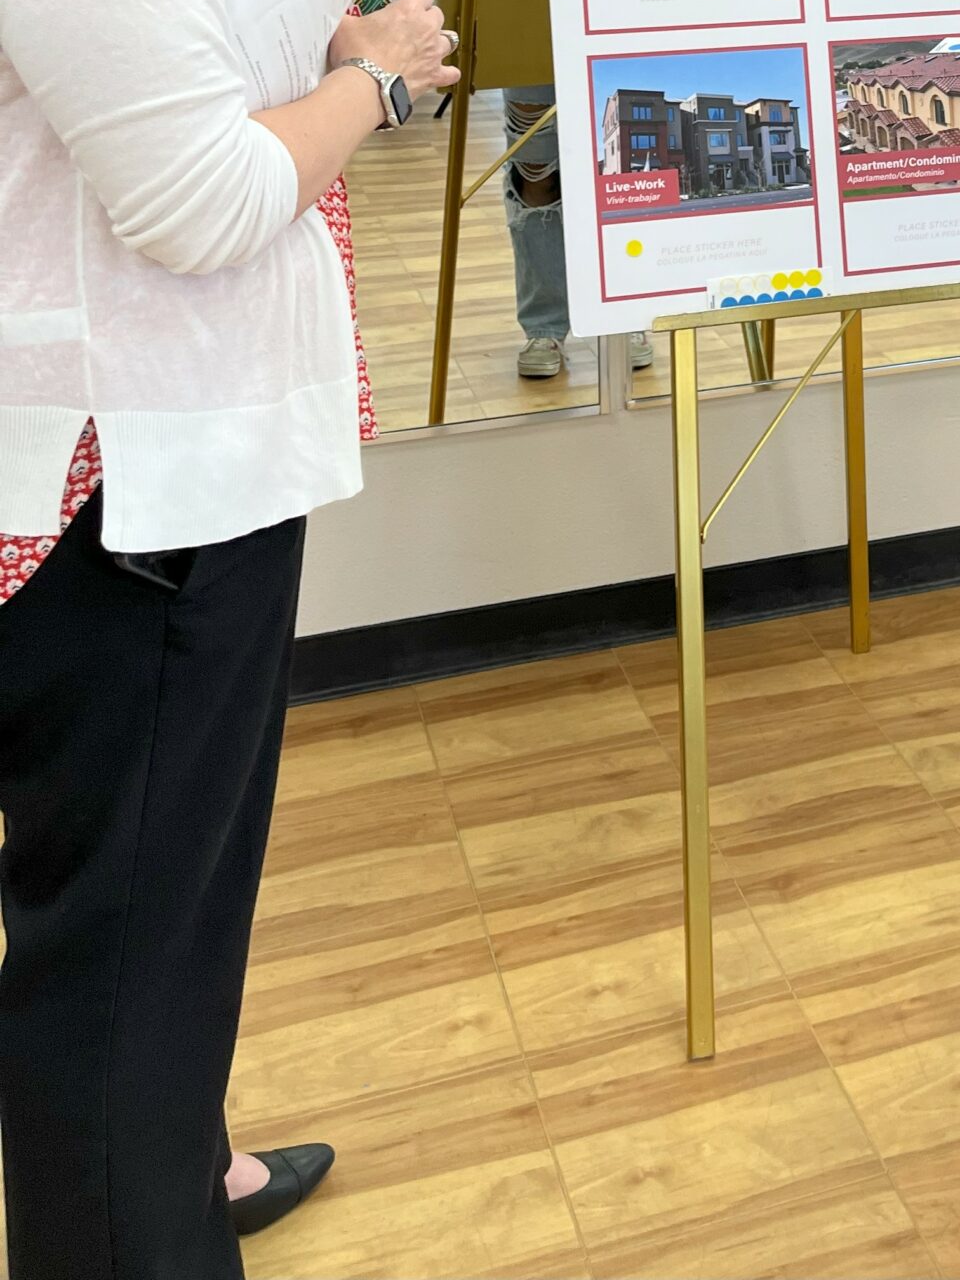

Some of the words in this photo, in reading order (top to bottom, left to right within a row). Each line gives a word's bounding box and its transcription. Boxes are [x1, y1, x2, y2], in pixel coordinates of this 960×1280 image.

[847, 168, 945, 184] Apartamento/Condominio
[605, 178, 666, 194] Live-Work
[606, 193, 661, 206] Vivir-trabajar
[898, 222, 926, 232] PLACE
[661, 244, 692, 255] PLACE
[696, 241, 735, 252] STICKER
